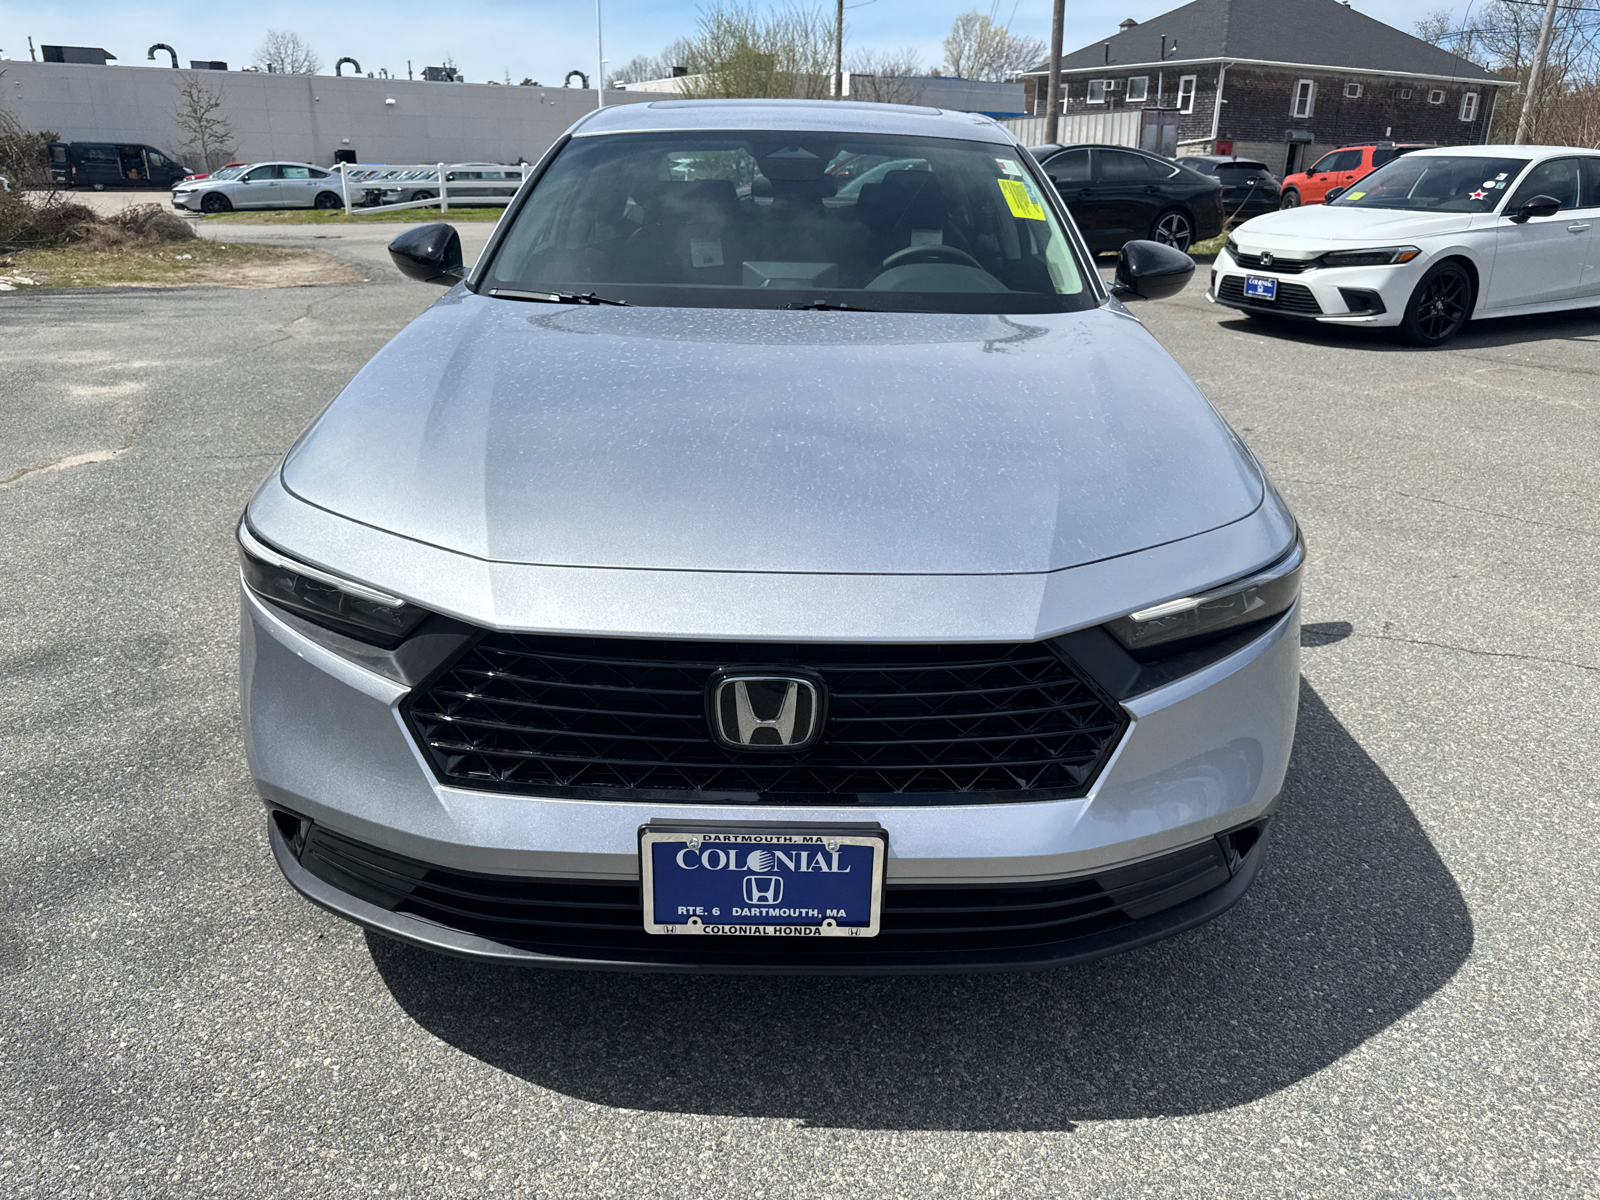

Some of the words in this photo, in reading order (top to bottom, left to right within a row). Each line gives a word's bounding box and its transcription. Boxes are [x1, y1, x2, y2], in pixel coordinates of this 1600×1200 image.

[703, 835, 797, 844] DARTMOUTH,
[803, 836, 823, 844] MA
[676, 848, 851, 873] COLONIAL
[678, 906, 708, 916] RTE.
[712, 907, 721, 916] 6
[732, 907, 822, 918] DARTMOUTH,
[826, 908, 847, 918] MA
[703, 925, 769, 935] COLONIAL
[773, 926, 822, 936] HONDA
